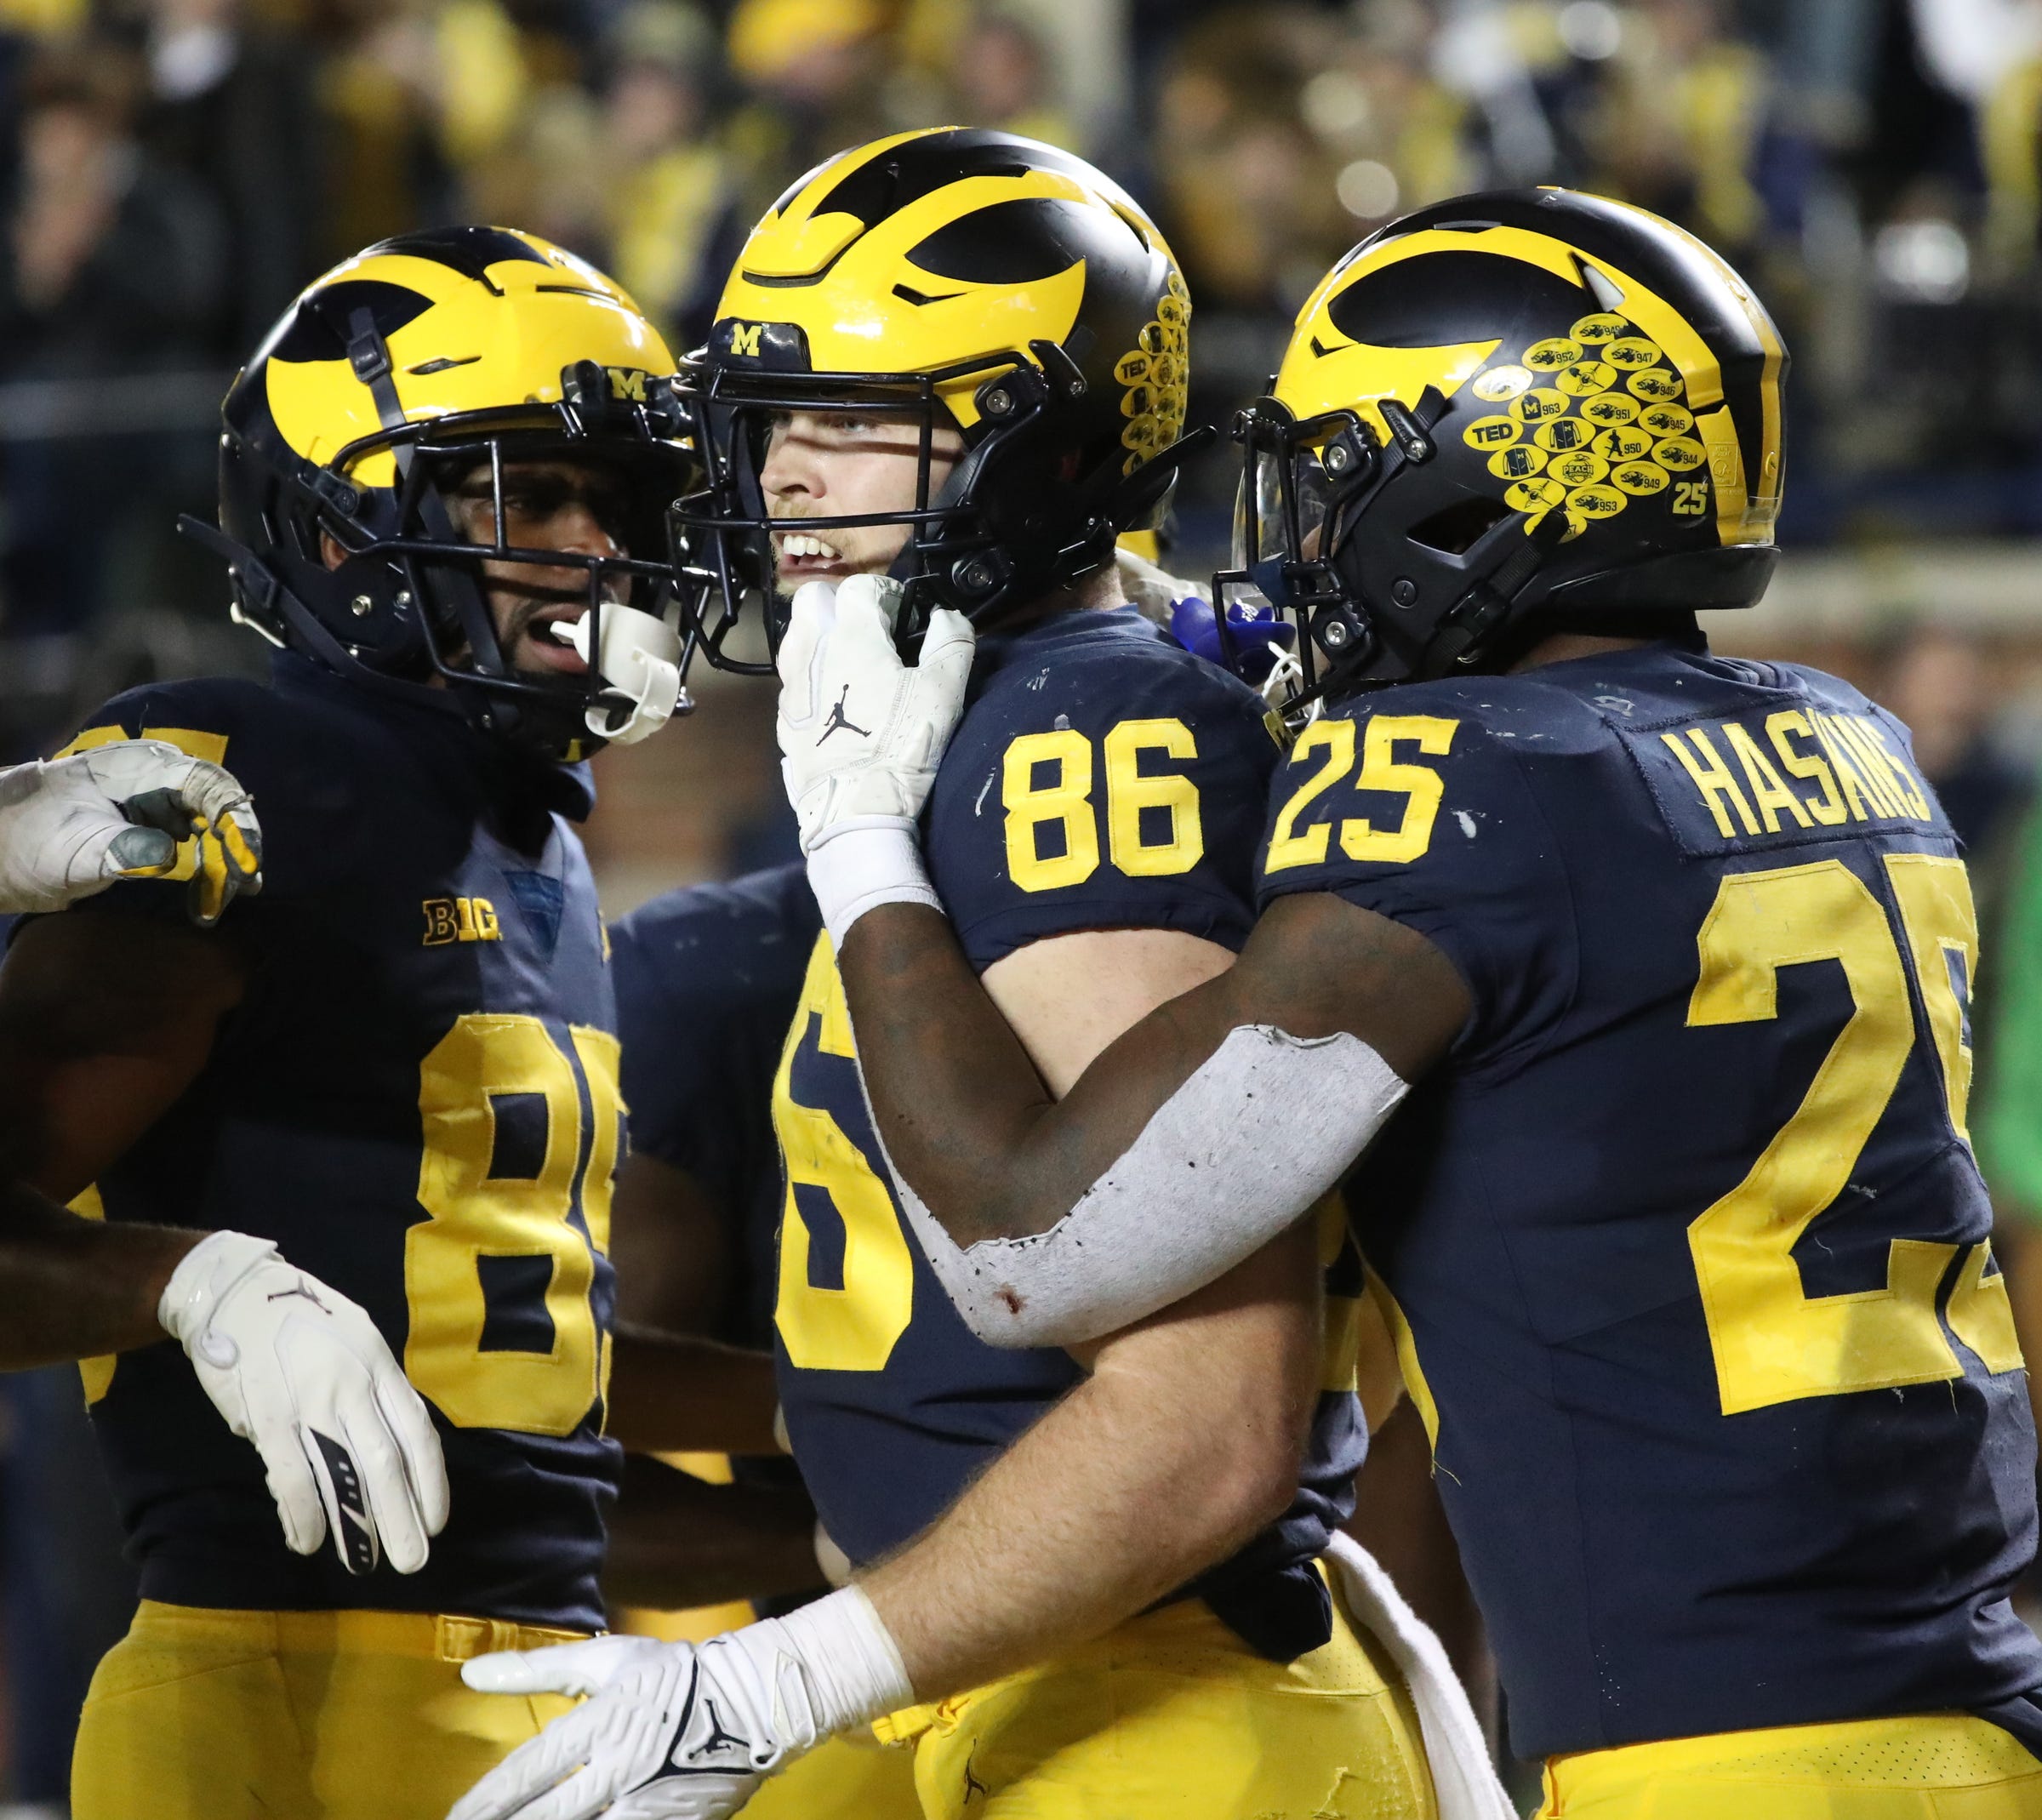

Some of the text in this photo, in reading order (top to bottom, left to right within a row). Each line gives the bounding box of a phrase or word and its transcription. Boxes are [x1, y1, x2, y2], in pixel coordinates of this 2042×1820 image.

[730, 322, 762, 357] M
[1555, 351, 1574, 363] 952
[1636, 352, 1652, 363] 947
[1121, 358, 1146, 379] TED
[607, 368, 647, 402] M
[1524, 402, 1538, 414] M
[1542, 402, 1560, 415] 963
[1616, 409, 1630, 419] 951
[1472, 422, 1514, 443] TED
[1623, 442, 1642, 454] 950
[1683, 454, 1698, 465] 944
[1563, 465, 1593, 475] PEACH
[1644, 478, 1660, 489] 949
[1672, 482, 1708, 516] 25
[1600, 500, 1617, 511] 953
[1660, 707, 1931, 838] HASKINS
[1264, 714, 1460, 875] 25
[1002, 717, 1204, 893] 86
